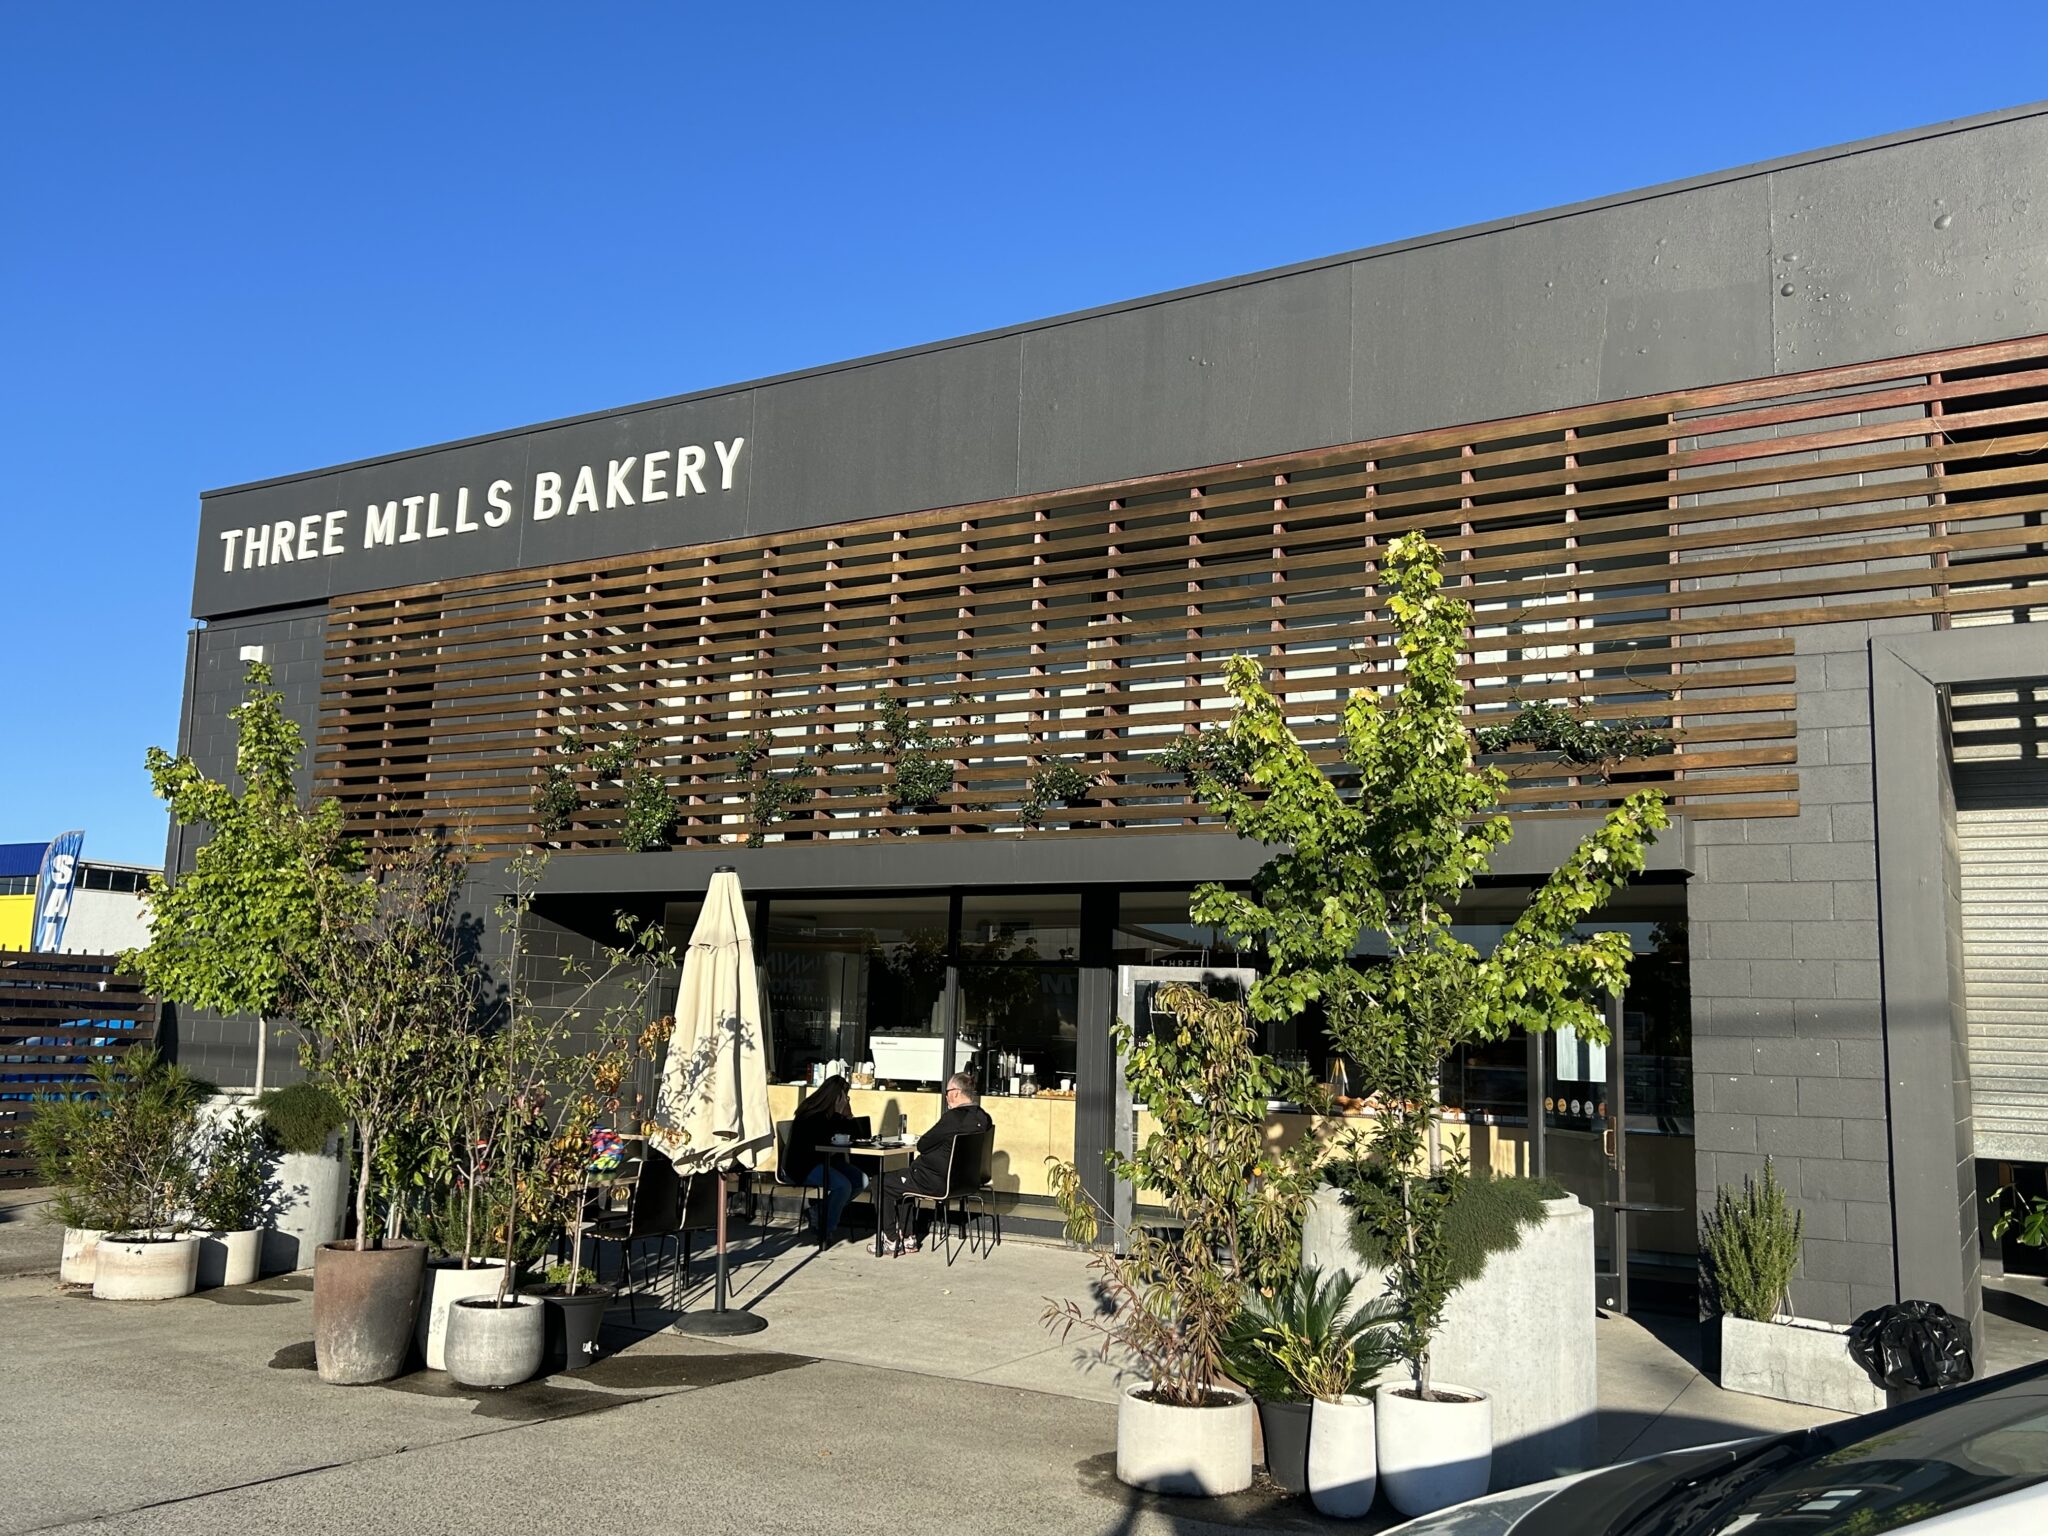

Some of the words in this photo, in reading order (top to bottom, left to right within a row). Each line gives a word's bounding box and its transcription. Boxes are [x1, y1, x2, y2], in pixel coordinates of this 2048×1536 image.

[220, 509, 348, 573] THREE
[363, 479, 513, 549] MILLS
[533, 437, 745, 521] BAKERY
